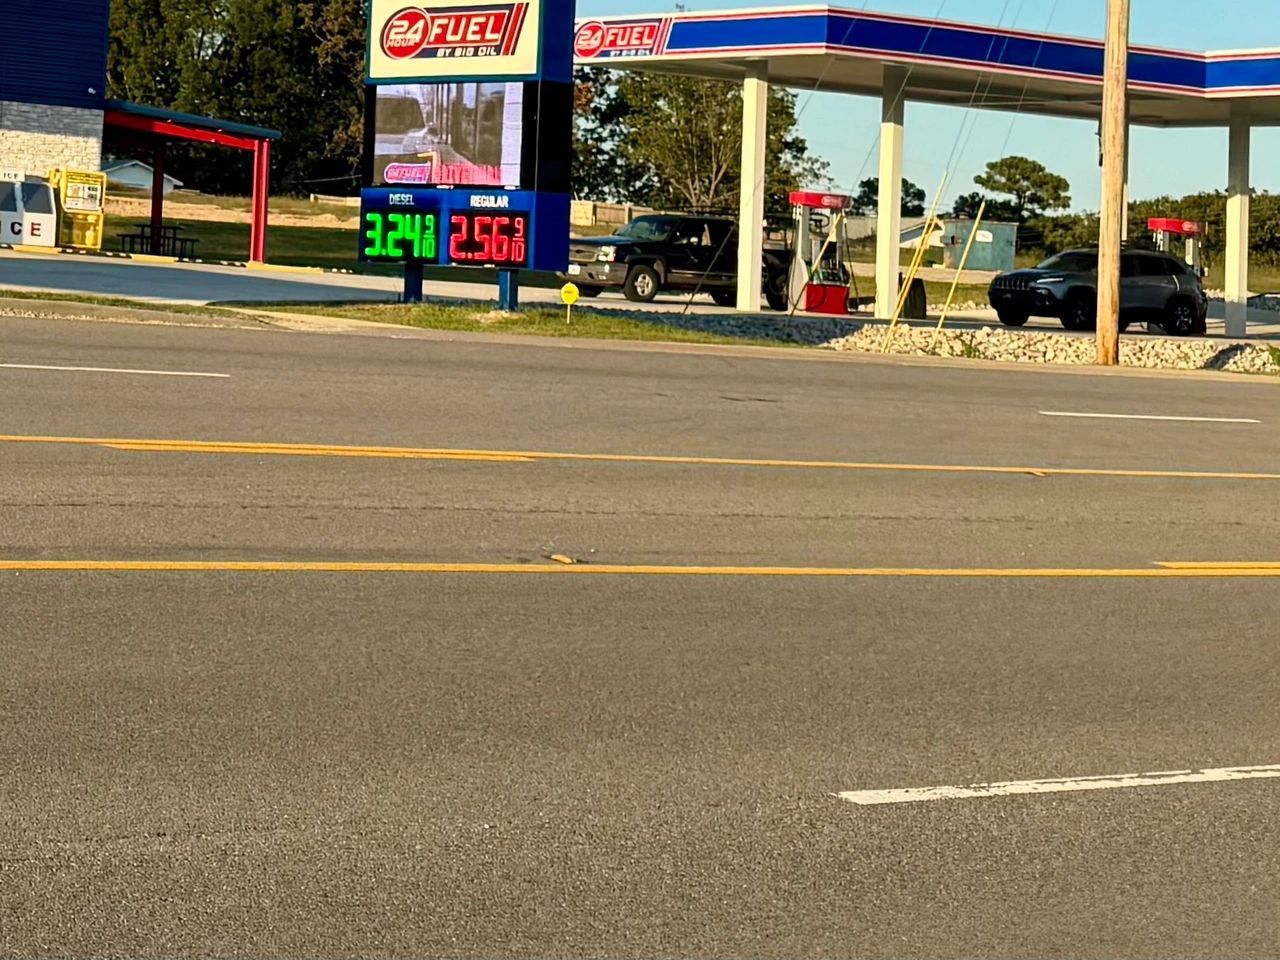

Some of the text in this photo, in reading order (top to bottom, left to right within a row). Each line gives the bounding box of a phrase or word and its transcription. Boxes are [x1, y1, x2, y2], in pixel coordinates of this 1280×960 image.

[389, 19, 425, 42] 24
[429, 16, 500, 42] FUEL
[578, 29, 602, 46] 24
[605, 26, 653, 47] FUEL
[436, 46, 497, 57] BY BIG OIL
[389, 193, 415, 205] DIESEL
[470, 195, 509, 208] REGULAR
[364, 212, 420, 258] 3.24
[449, 215, 510, 261] 2.56
